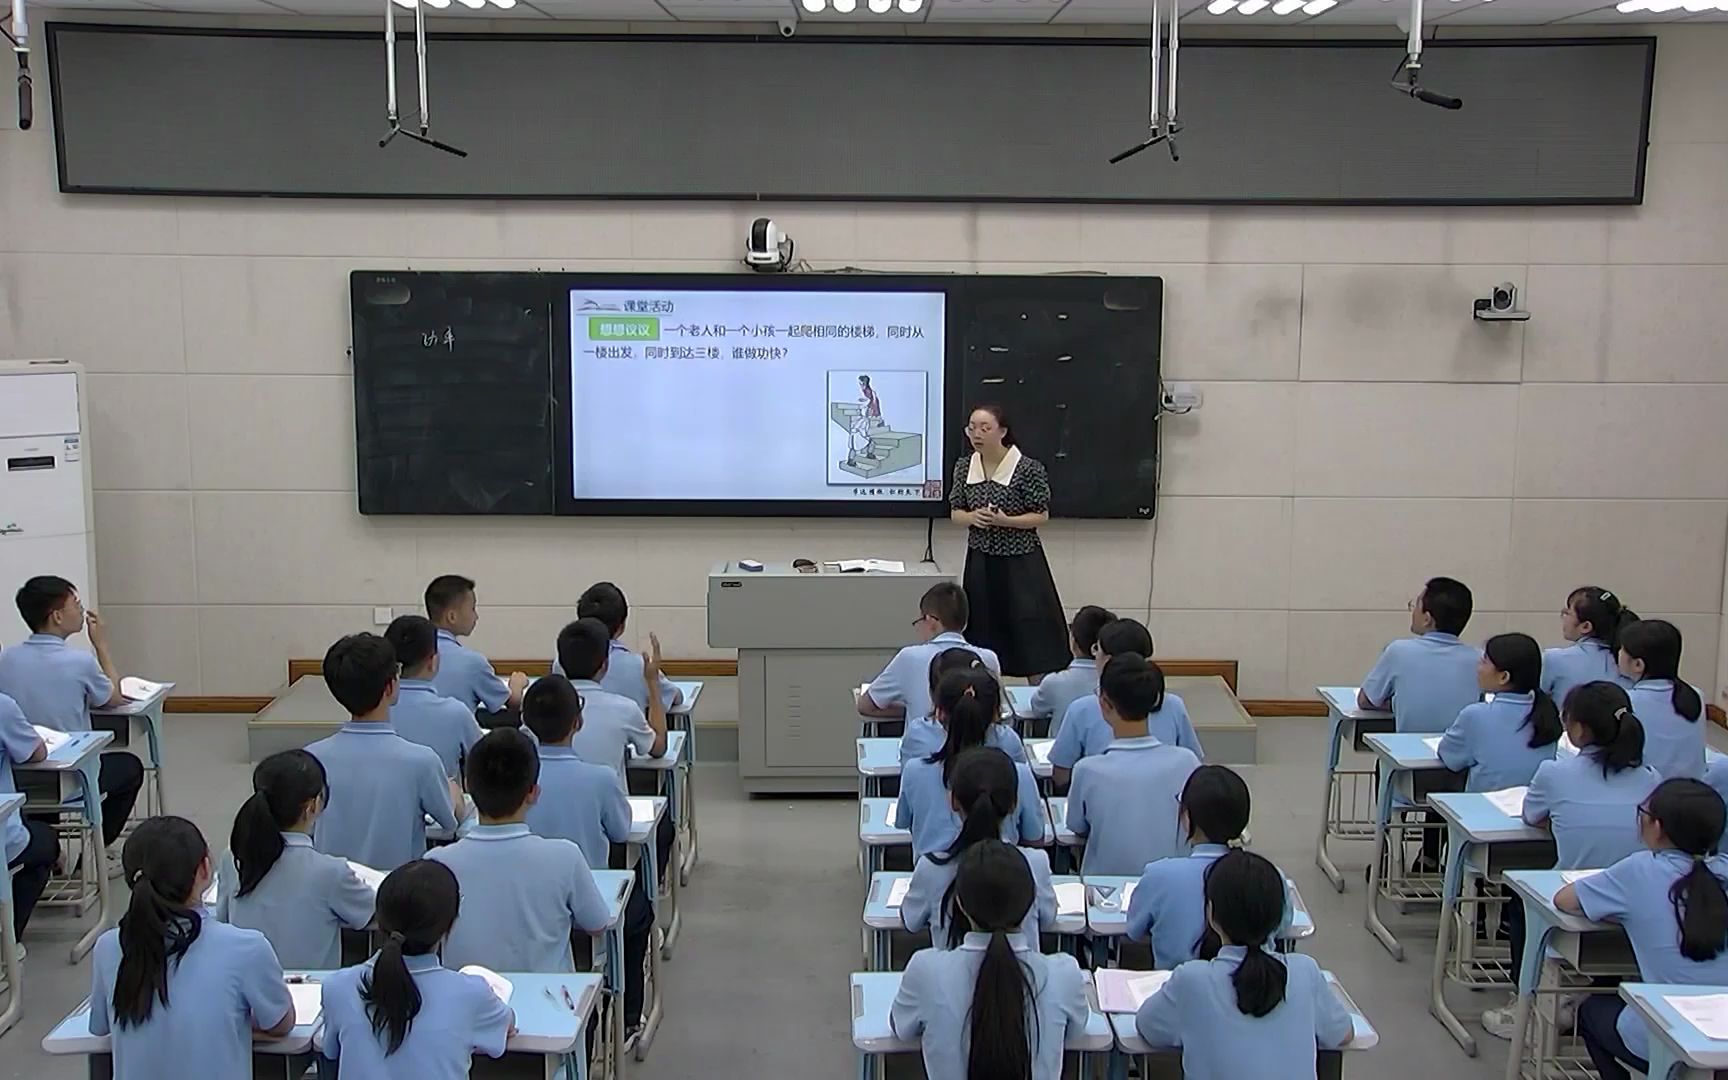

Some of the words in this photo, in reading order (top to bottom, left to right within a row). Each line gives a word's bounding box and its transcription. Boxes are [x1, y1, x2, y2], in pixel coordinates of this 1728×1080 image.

[623, 300, 674, 313] 课堂活动
[600, 322, 650, 337] 想想议议
